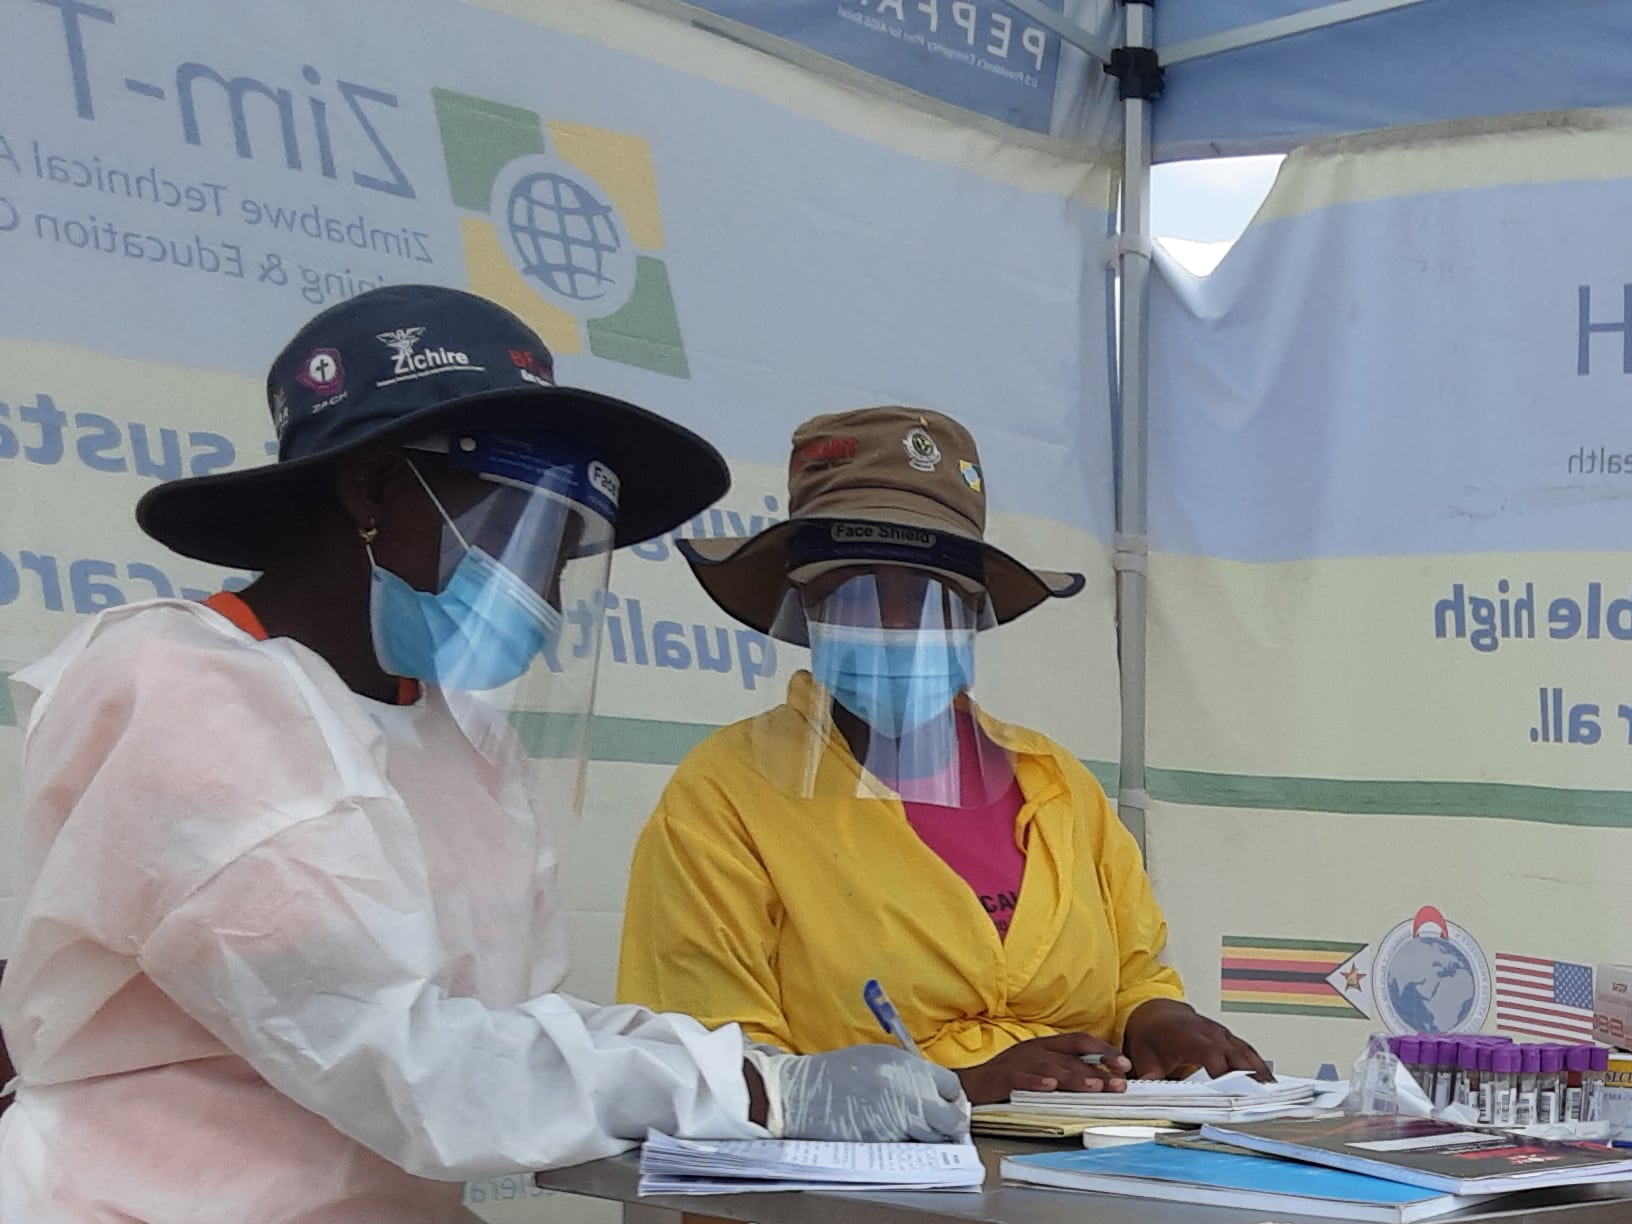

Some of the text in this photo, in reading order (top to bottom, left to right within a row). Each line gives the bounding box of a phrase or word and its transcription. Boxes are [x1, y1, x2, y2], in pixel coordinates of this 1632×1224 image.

[391, 347, 469, 375] Zichire
[834, 524, 931, 544] Face Shield
